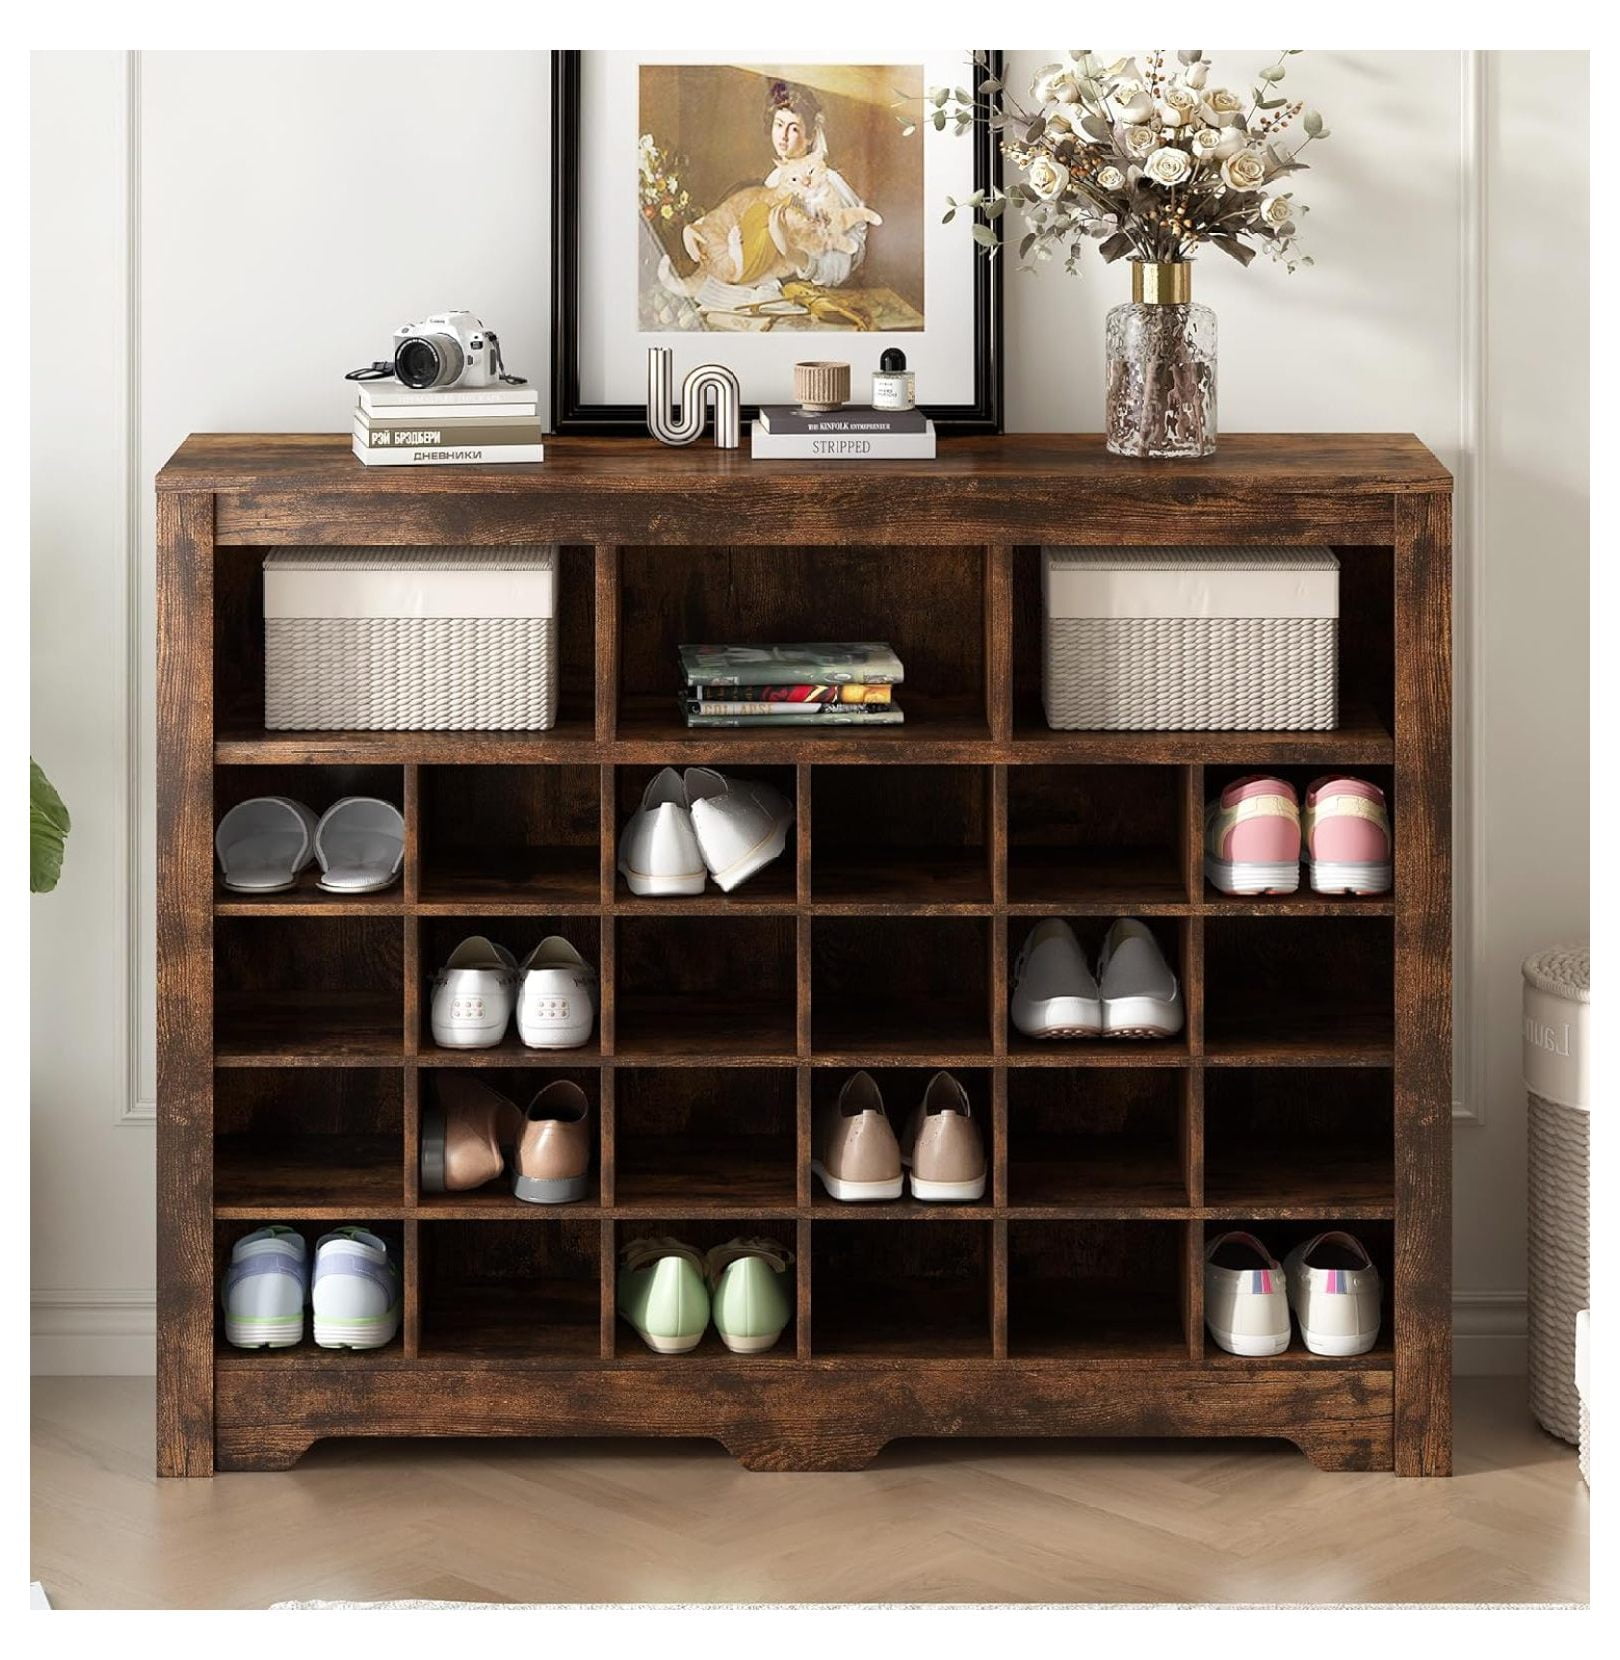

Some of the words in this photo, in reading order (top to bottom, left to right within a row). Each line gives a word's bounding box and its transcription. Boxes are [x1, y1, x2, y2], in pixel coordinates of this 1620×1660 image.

[819, 421, 850, 431] KINFOLK
[371, 430, 391, 445] РЭЙ
[394, 430, 441, 445] БРЭДБЕРИ
[812, 440, 871, 454] STRIPPED
[413, 450, 482, 461] ДНЕВНИКИ
